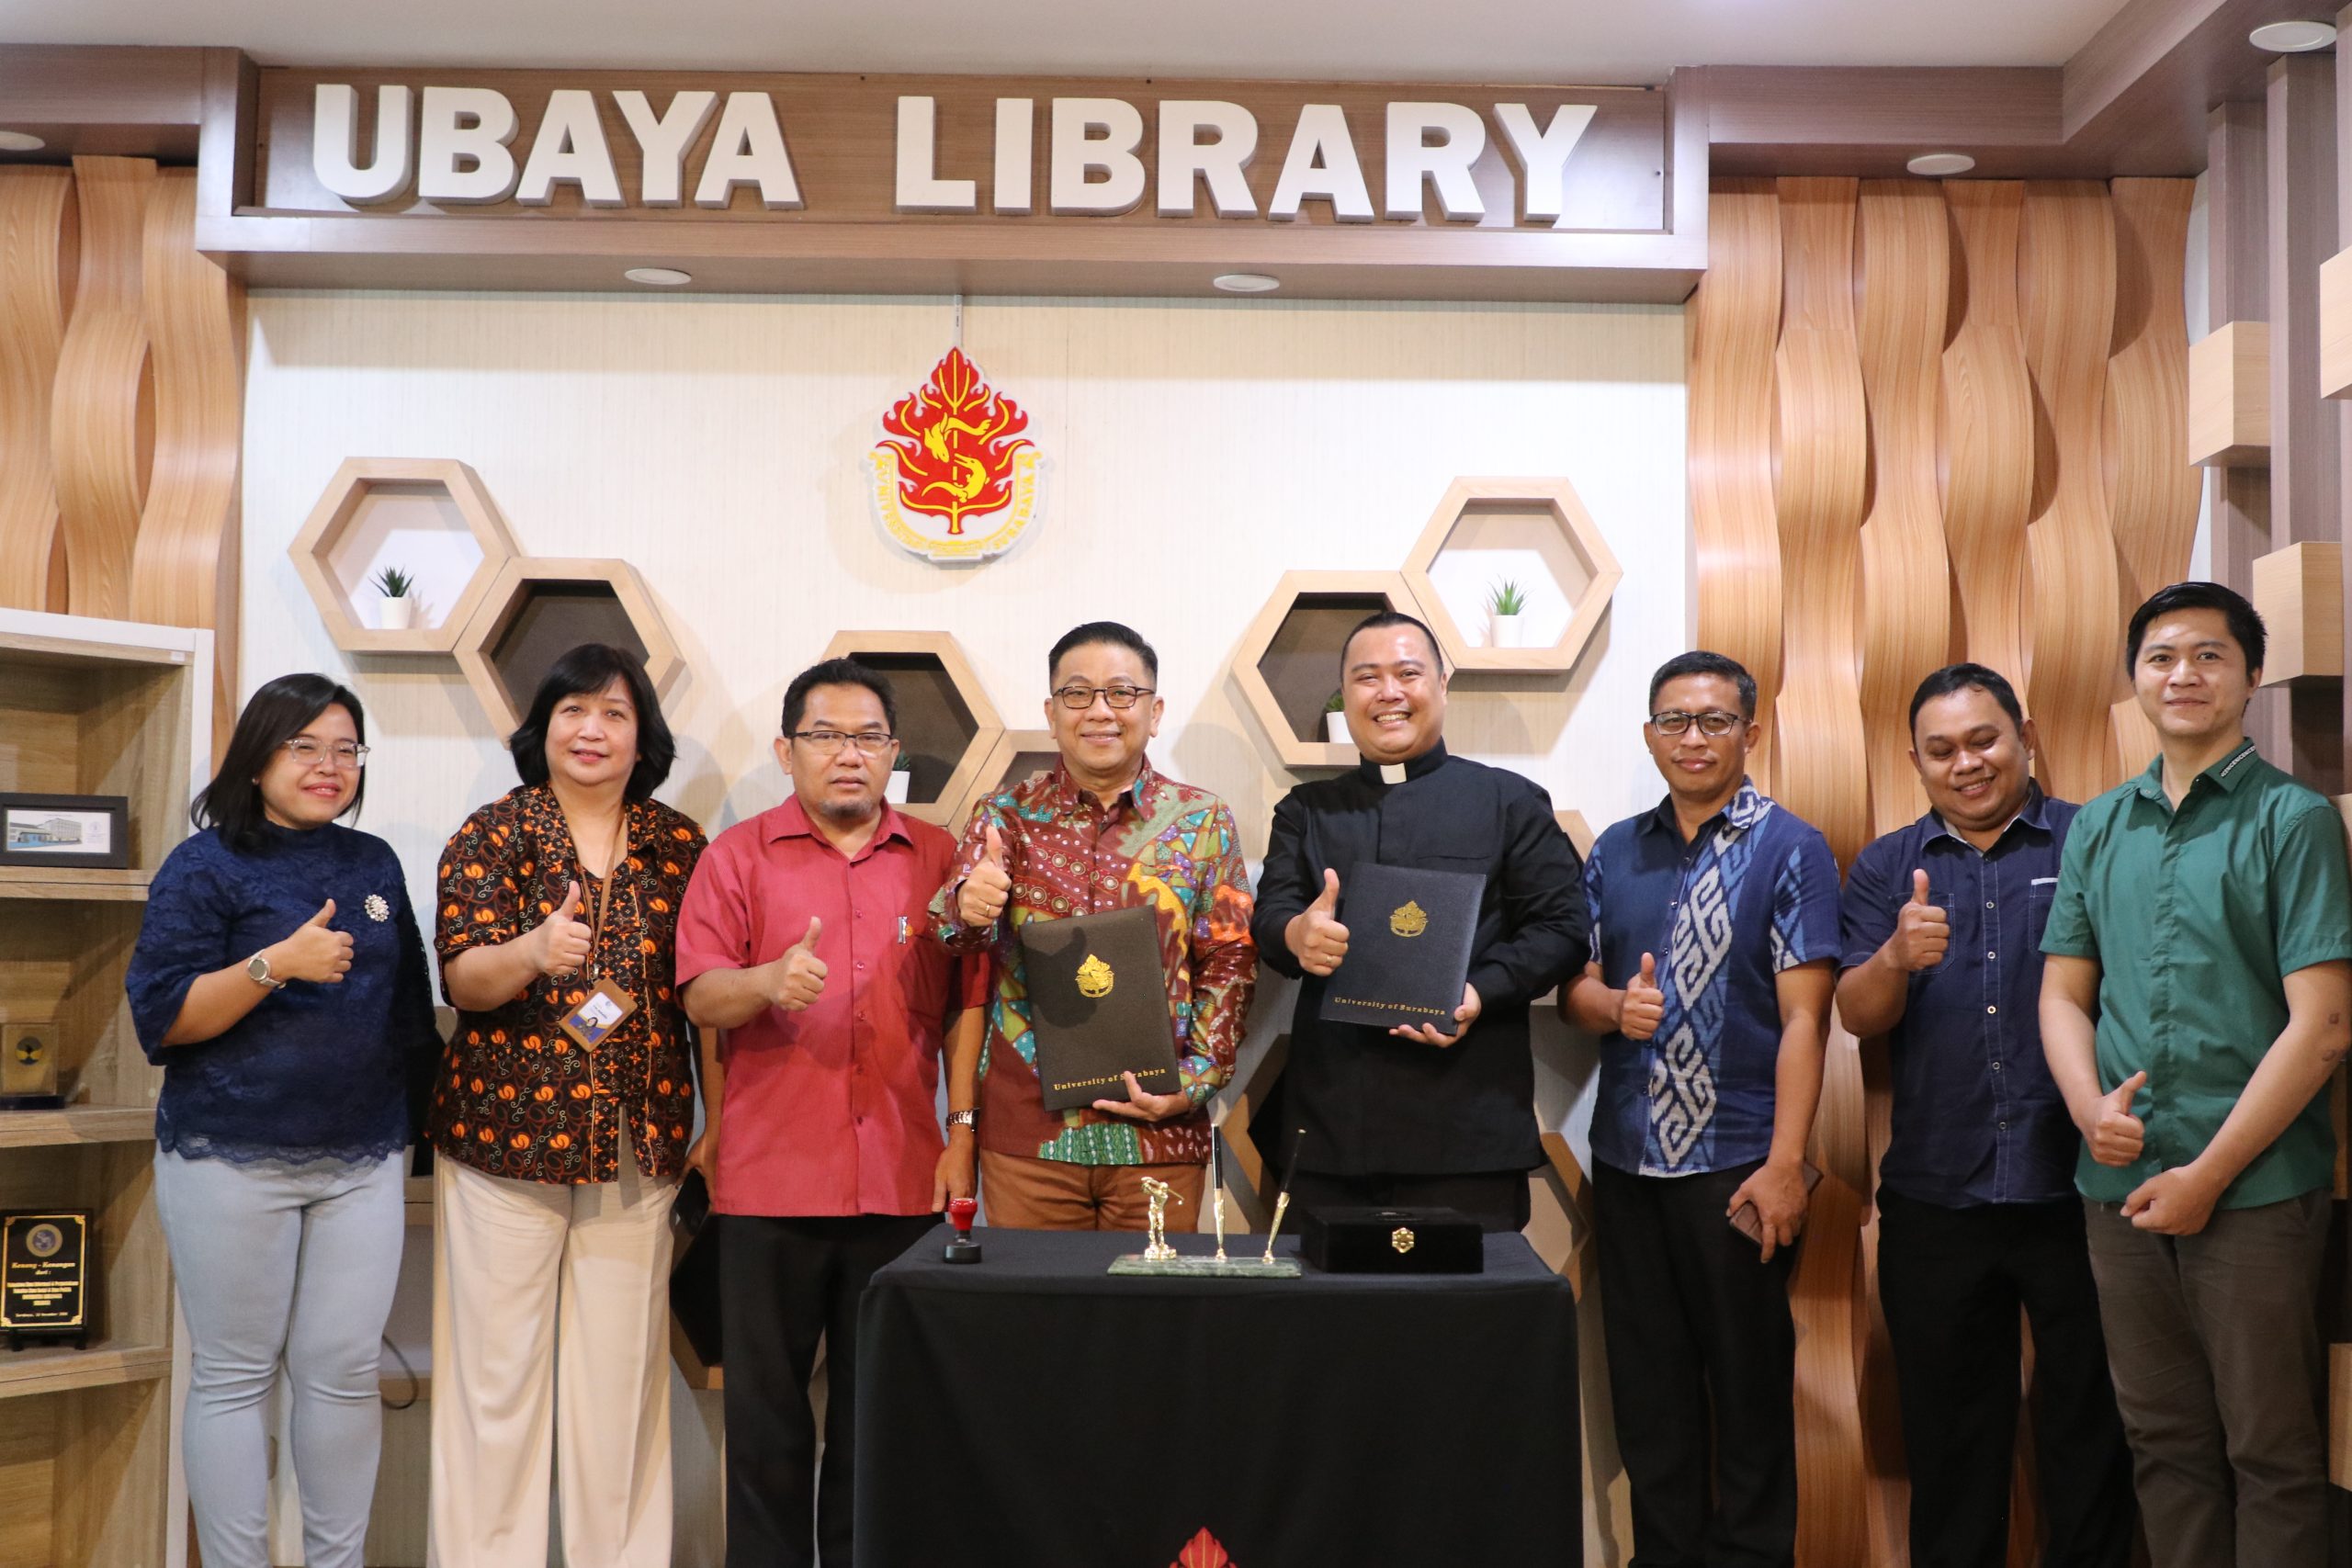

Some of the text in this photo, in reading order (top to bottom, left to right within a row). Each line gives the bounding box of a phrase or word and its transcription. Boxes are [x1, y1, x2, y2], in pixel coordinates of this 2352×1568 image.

[312, 83, 1599, 223] UBAYA LIBRARY
[1334, 997, 1385, 1010] University
[1399, 1004, 1446, 1016] Surabaya
[1053, 1067, 1166, 1091] University of Srabaya
